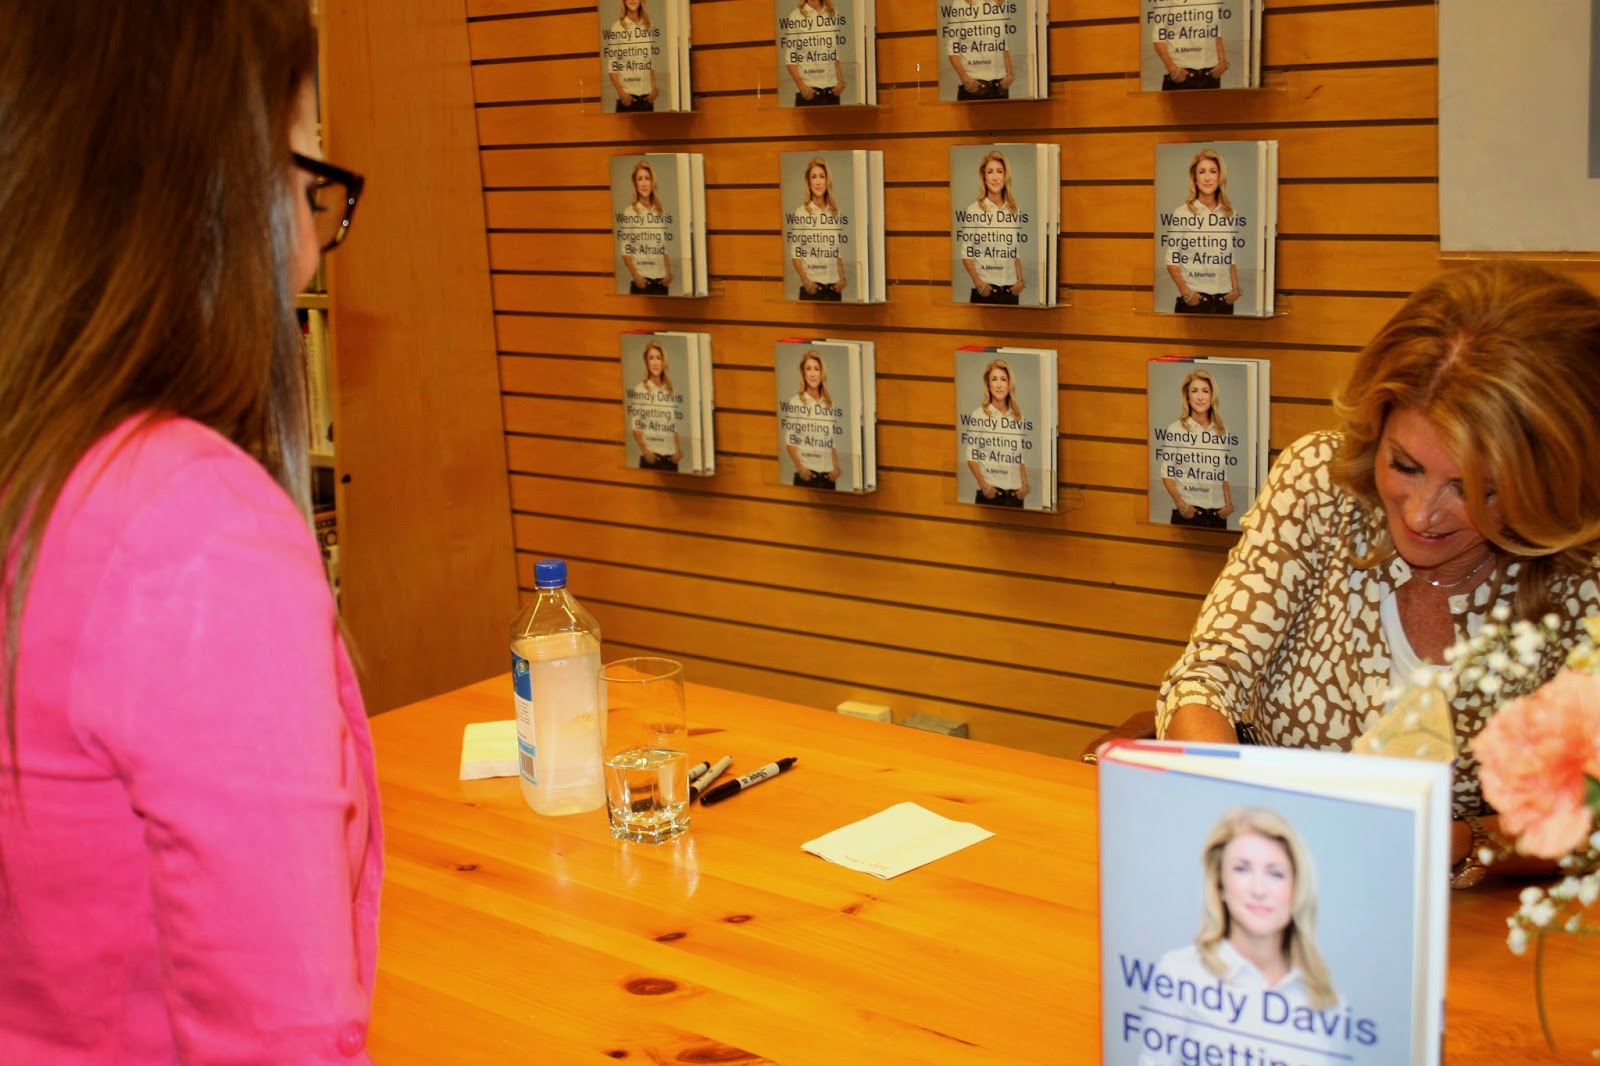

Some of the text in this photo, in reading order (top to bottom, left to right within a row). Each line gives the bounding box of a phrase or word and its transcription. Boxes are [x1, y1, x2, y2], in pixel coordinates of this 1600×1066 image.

[941, 2, 1016, 18] Wendy Davis
[1147, 8, 1231, 25] Forgetting to
[779, 14, 846, 30] Wendy Davis
[603, 27, 660, 40] Wendy Davis
[942, 24, 1016, 39] Forgetting to
[1159, 25, 1218, 40] Be Afraid
[781, 35, 846, 50] Forgetting to
[953, 39, 1005, 53] Be Afraid
[604, 46, 659, 59] Forgetting to
[790, 50, 836, 62] Be Afraid
[612, 60, 651, 71] Be Afraid
[615, 213, 672, 225] Wendy Davis
[786, 213, 848, 227] Wendy Davis
[956, 211, 1028, 225] Wendy Davis
[1160, 214, 1246, 229] Wendy Davis
[617, 231, 672, 243] Forgetting to
[787, 232, 848, 245] Forgetting to
[957, 231, 1028, 245] Forgetting to
[1161, 235, 1245, 250] Forgetting to
[625, 245, 665, 254] Be Afraid
[795, 247, 838, 258] Be Afraid
[967, 247, 1016, 258] Be Afraid
[1172, 252, 1232, 264] Be Afraid
[626, 389, 683, 403] Wendy Davis
[627, 406, 683, 421] Forgetting to
[780, 401, 843, 417] Wendy Davis
[635, 420, 675, 432] Be Afraid
[782, 419, 842, 436] Forgetting to
[961, 414, 1033, 430] Wendy Davis
[790, 435, 833, 448] Be Afraid
[961, 433, 1032, 451] Forgetting to
[1155, 428, 1238, 445] Wendy Davis
[972, 449, 1021, 463] Be Afraid
[1156, 449, 1238, 467] Forgetting to
[1167, 466, 1225, 481] Be Afraid
[1119, 954, 1378, 1046] Wendy Davis
